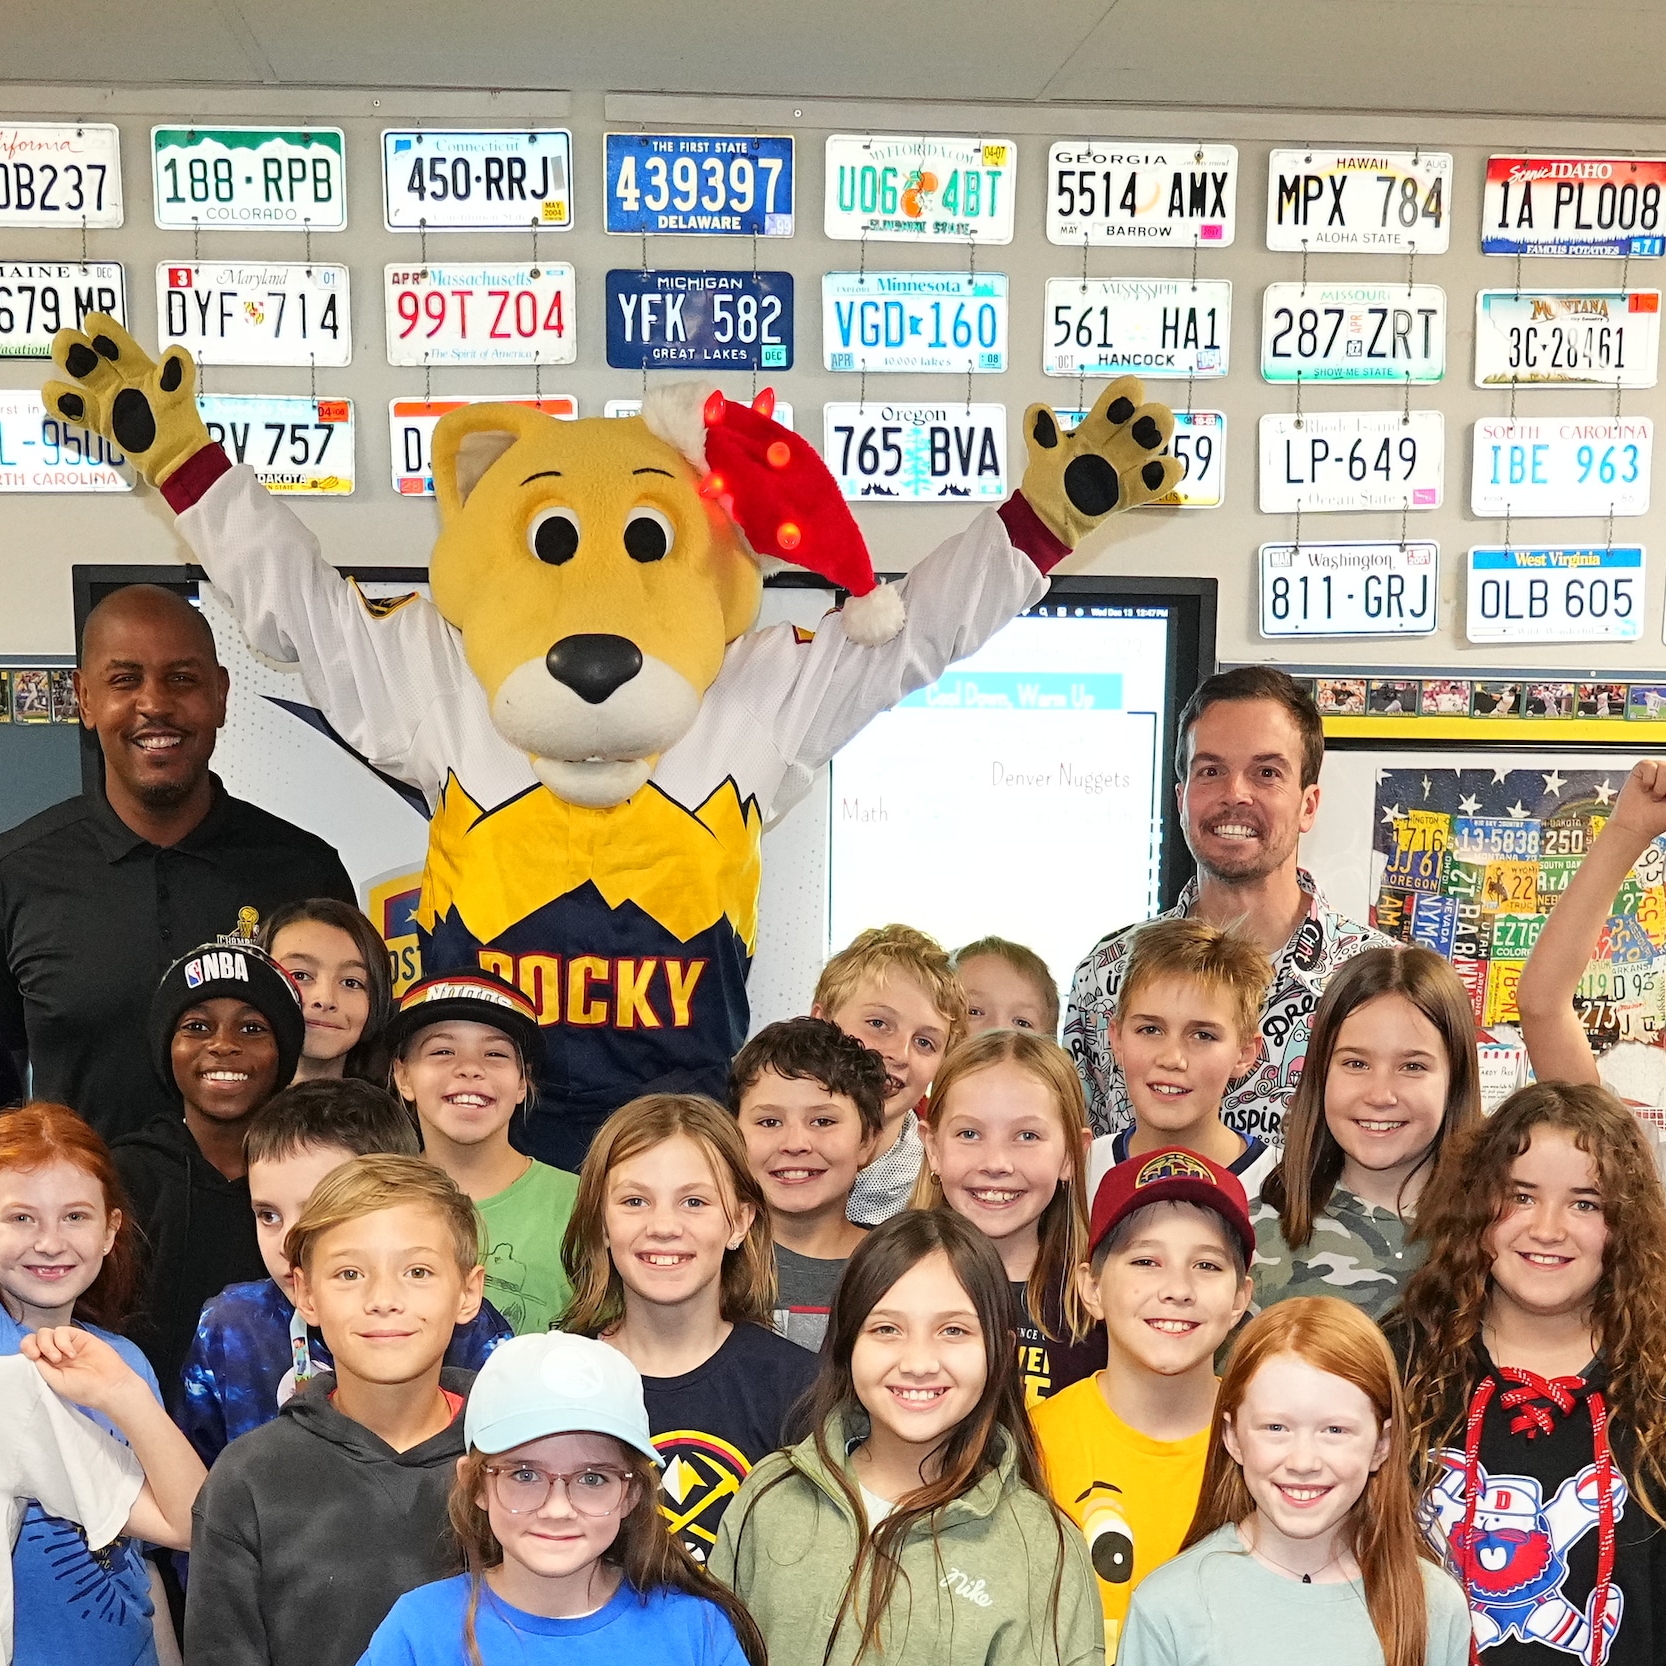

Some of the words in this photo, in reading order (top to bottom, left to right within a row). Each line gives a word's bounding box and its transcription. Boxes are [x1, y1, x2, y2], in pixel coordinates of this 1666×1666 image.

[652, 142, 672, 152] THE
[679, 142, 706, 152] FIRST
[713, 143, 748, 154] STATE
[1337, 157, 1389, 170] HAWAII
[1549, 163, 1612, 179] IDAHO
[616, 157, 784, 214] 439397
[1058, 170, 1136, 217] 5514
[1168, 170, 1226, 218] AMX
[1278, 175, 1345, 226] MPX
[1378, 176, 1442, 228] 784
[207, 207, 297, 221] COLORADO
[658, 216, 741, 230] DELAWARE
[658, 277, 742, 290] MICHIGAN
[617, 295, 685, 343] YFK
[713, 296, 783, 345] 582
[652, 348, 697, 359] GREAT
[704, 349, 748, 361] LAKES
[881, 407, 946, 425] Oregon
[834, 426, 901, 475] 765
[931, 428, 1001, 477] BVA
[992, 761, 1052, 787] Denver
[1059, 763, 1130, 794] Nuggets
[202, 953, 249, 983] NBA
[939, 1566, 994, 1609] Nike
